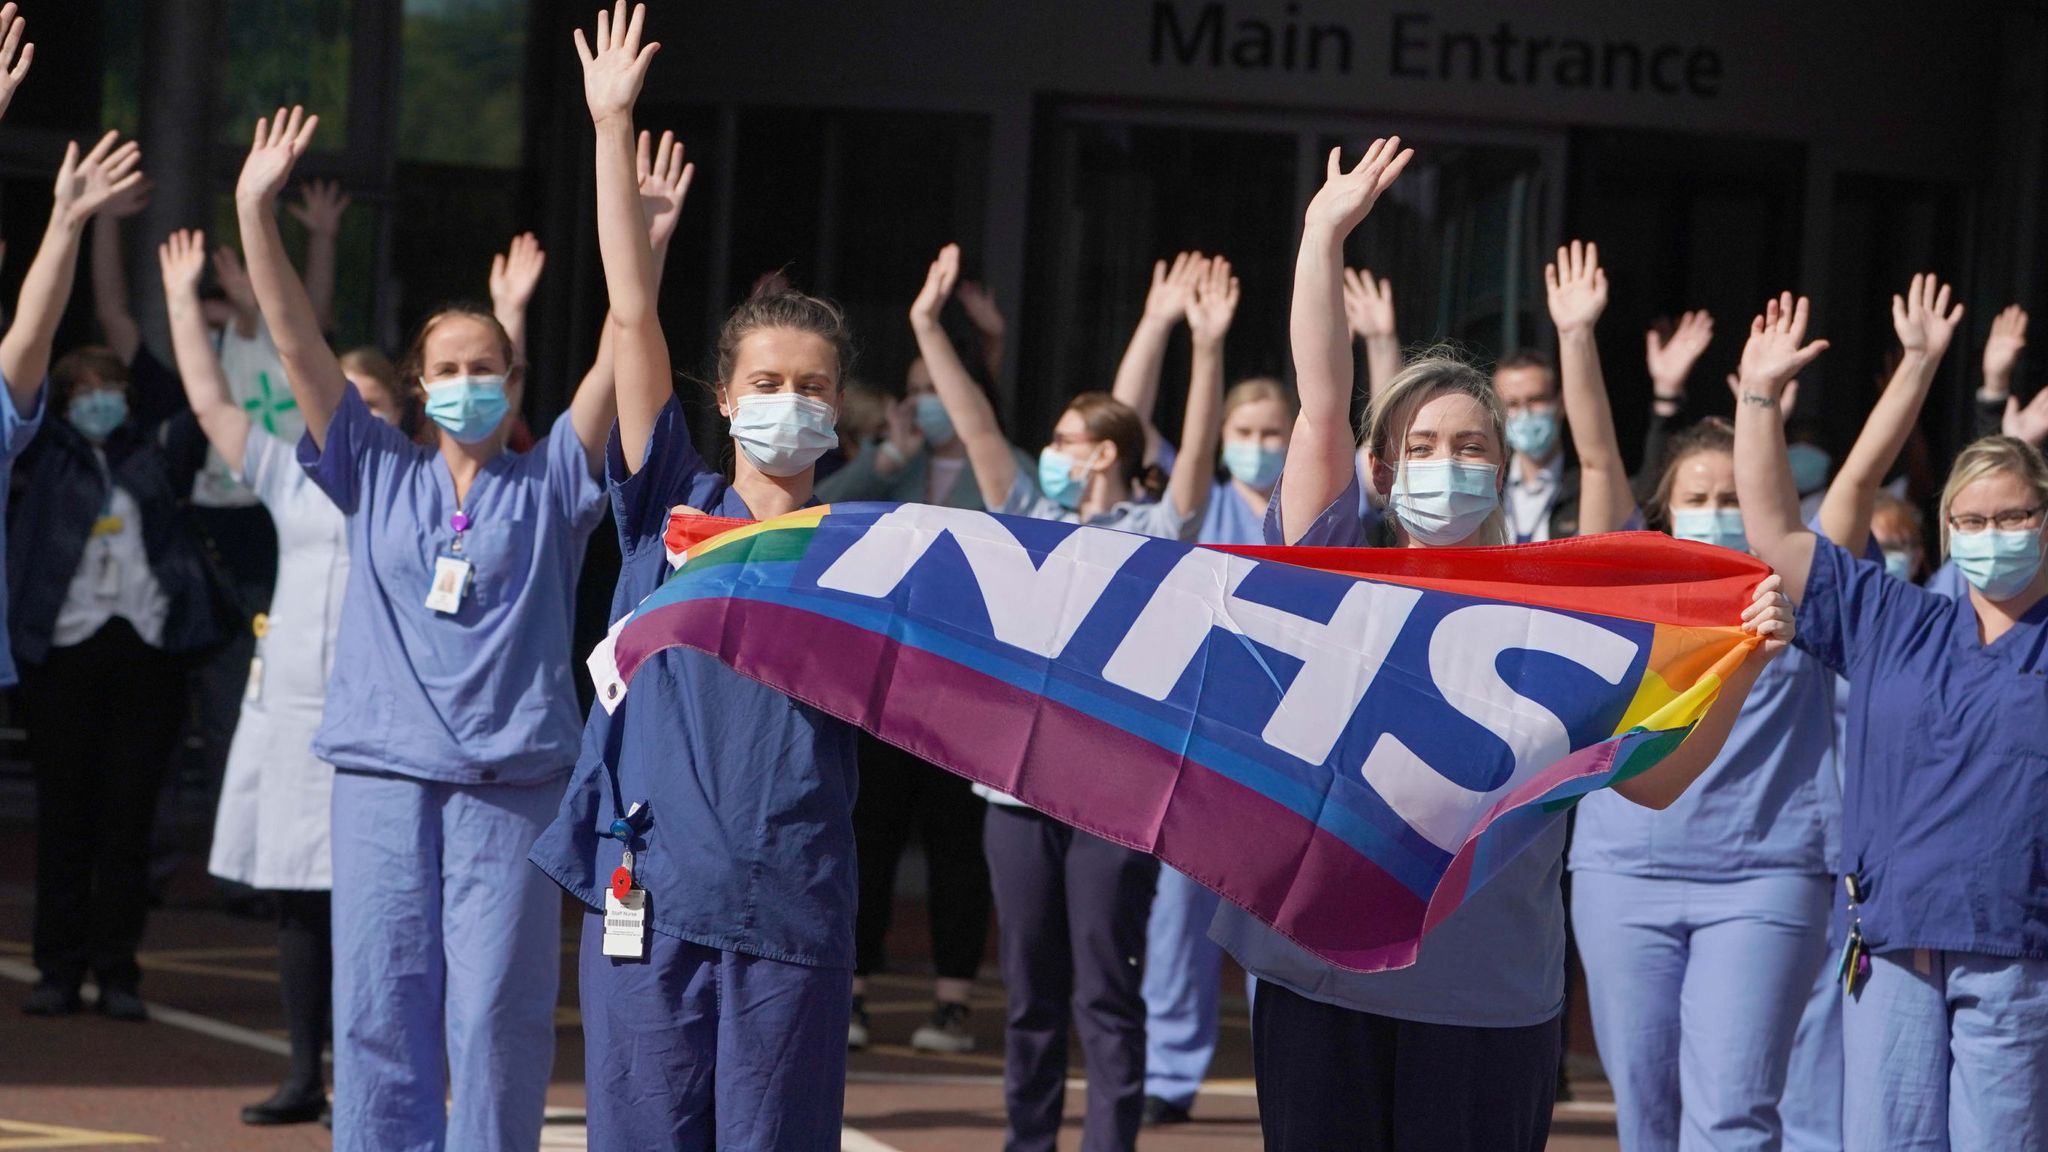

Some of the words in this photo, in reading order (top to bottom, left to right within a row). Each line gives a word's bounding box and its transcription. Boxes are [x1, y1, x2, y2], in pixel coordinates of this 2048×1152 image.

[1148, 0, 1354, 75] Main
[1388, 11, 1725, 99] Entrance
[816, 502, 1639, 853] NHS
